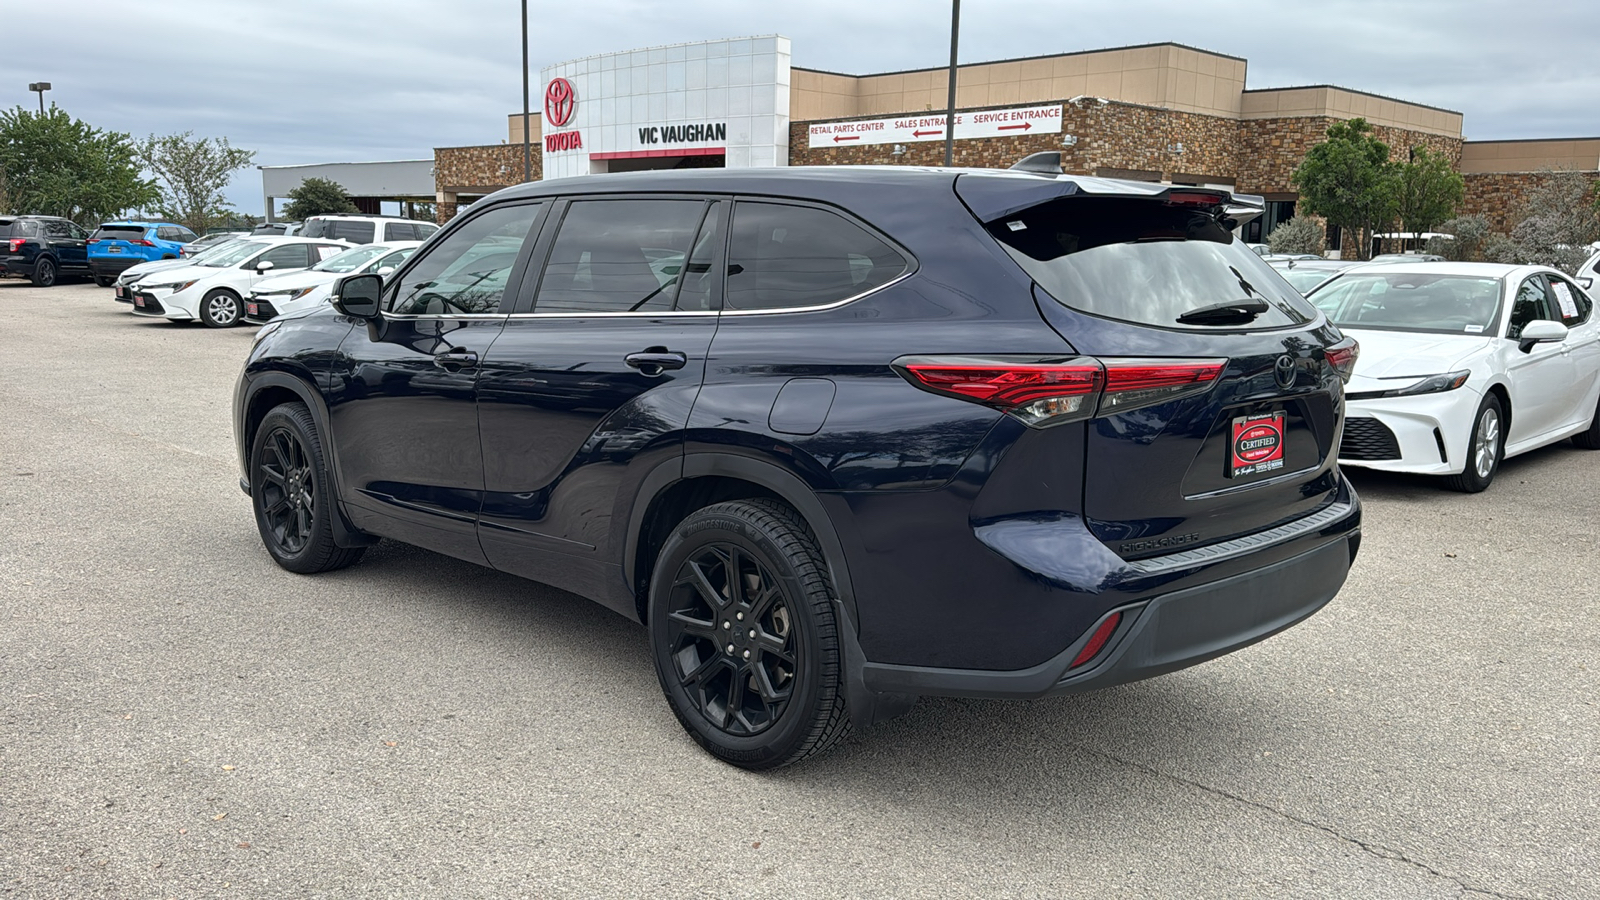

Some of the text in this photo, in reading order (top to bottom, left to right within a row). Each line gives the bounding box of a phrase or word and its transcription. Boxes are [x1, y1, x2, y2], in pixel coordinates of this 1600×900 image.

[894, 116, 962, 129] SALES ENTRACE
[973, 108, 1060, 124] SERVICE ENTRANCE
[638, 123, 726, 144] VIC VAUGHAN
[810, 122, 884, 135] RETAIL PARTS CENTER
[545, 130, 582, 152] TOYOTA
[687, 519, 740, 537] BRIDGESTONE
[1119, 532, 1199, 552] HIGHLANDER
